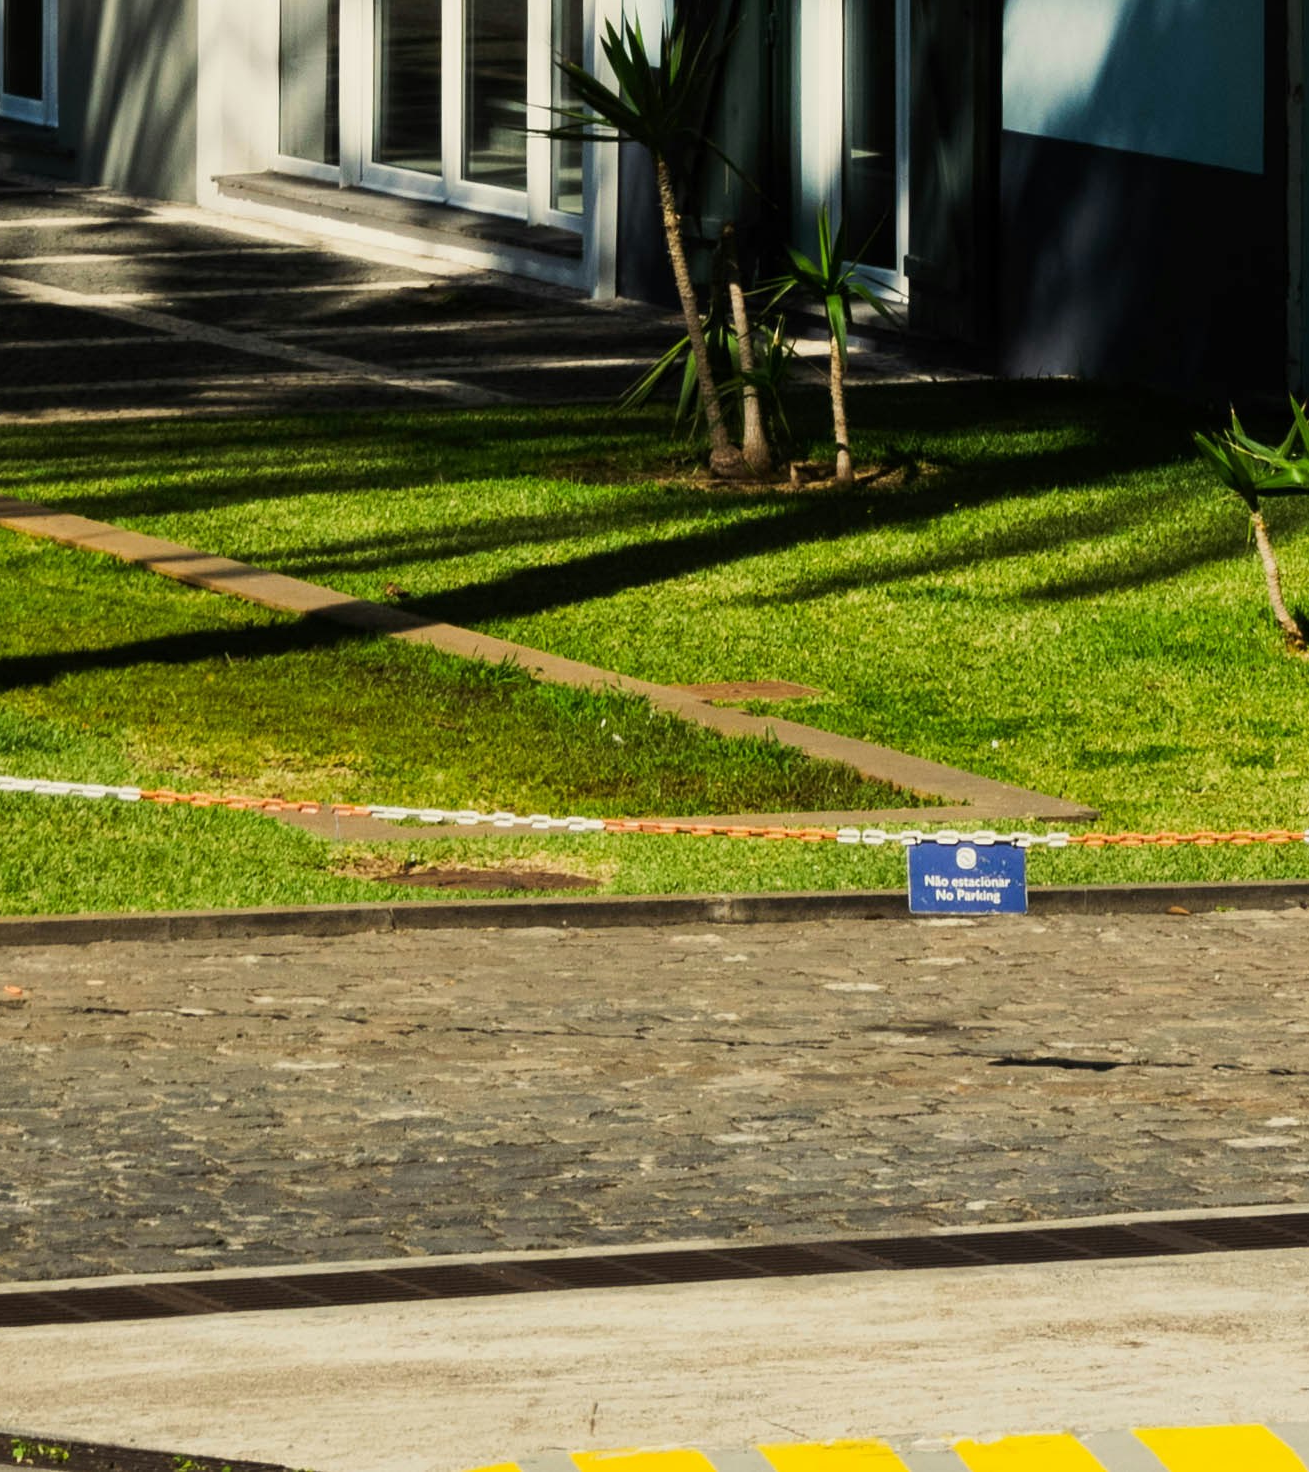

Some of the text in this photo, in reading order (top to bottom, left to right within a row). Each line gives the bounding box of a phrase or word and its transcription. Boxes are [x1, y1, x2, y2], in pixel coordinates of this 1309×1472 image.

[924, 874, 1011, 888] Não estacionar
[935, 888, 1001, 904] No Parking
